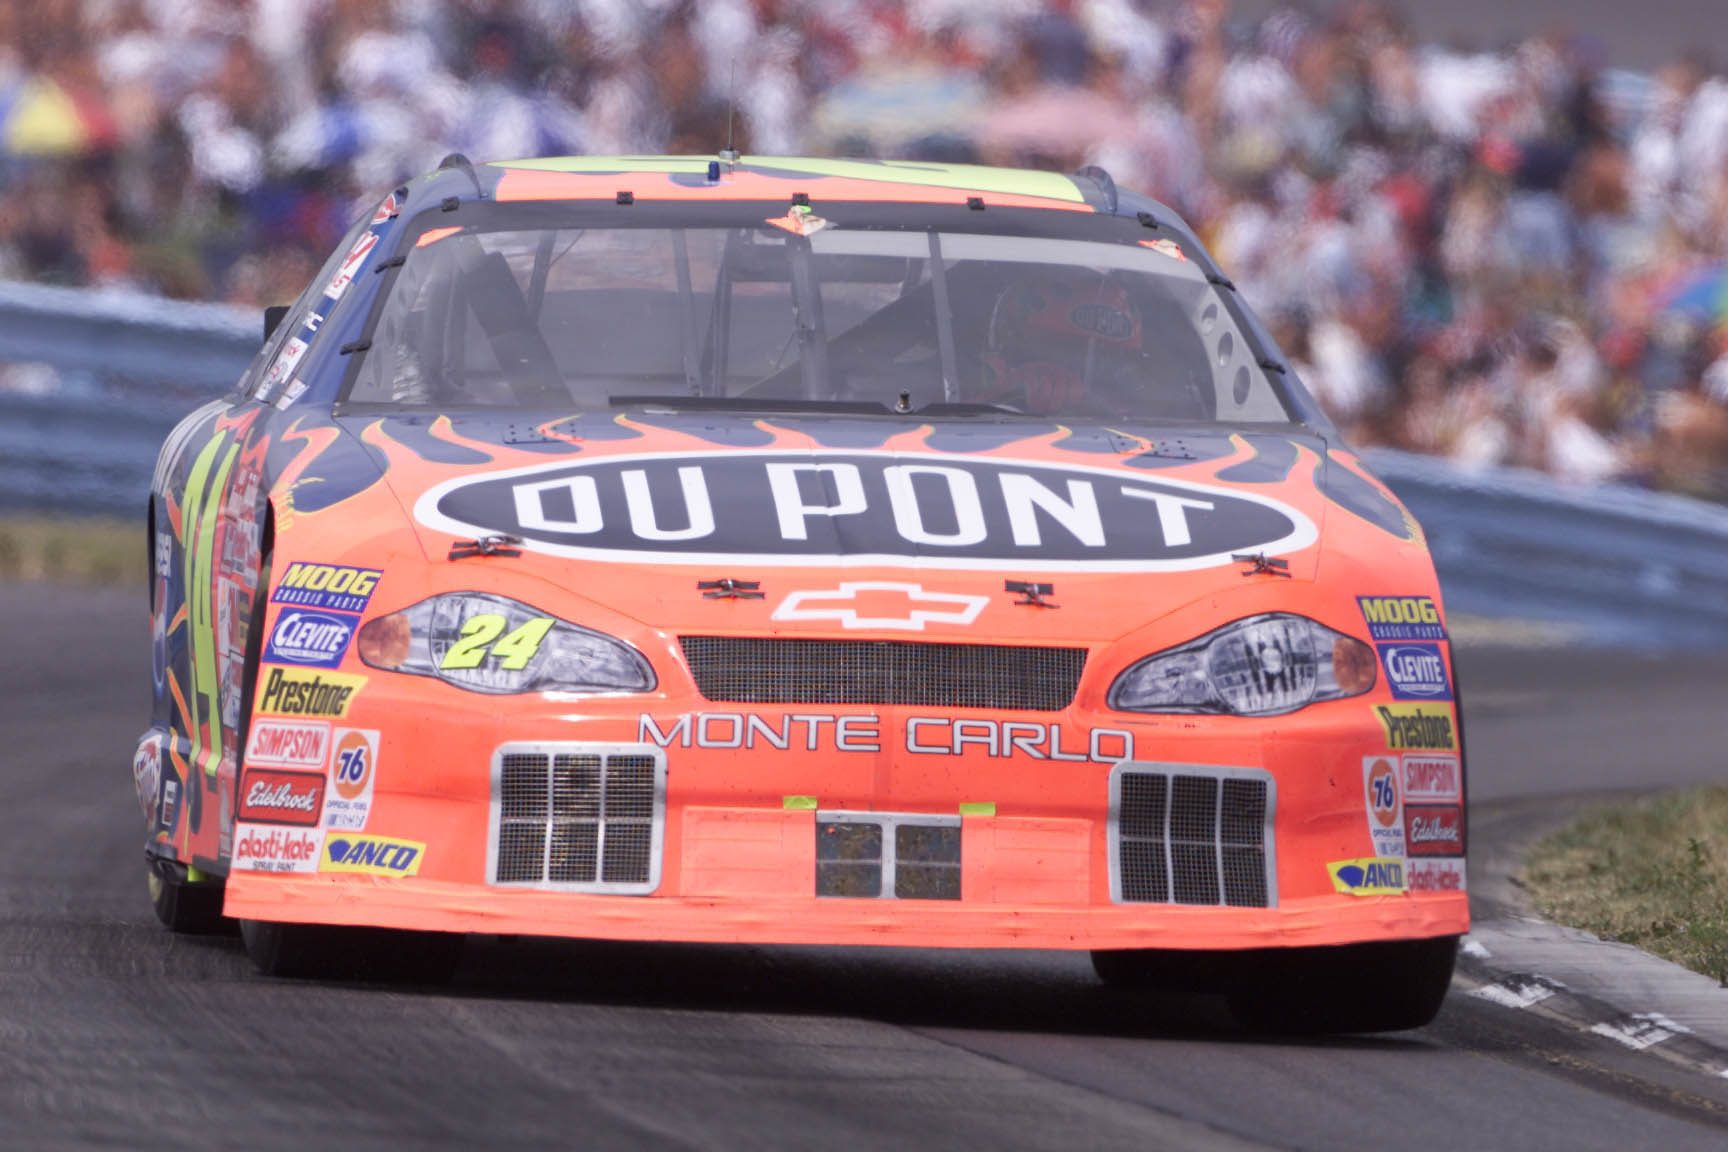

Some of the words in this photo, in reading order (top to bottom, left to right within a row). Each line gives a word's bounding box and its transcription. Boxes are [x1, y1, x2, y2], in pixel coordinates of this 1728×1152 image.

[512, 466, 715, 540] DU
[765, 463, 1214, 547] PONT
[279, 563, 382, 596] MOOG
[1360, 598, 1438, 624] MOOG
[274, 612, 350, 652] CLEVITE
[439, 614, 556, 671] 24
[1386, 648, 1443, 682] CLEVITE
[261, 668, 353, 716] Prestone
[252, 727, 325, 760] SIMPSON
[637, 712, 881, 752] MONTE
[906, 717, 1134, 764] CARLO
[338, 748, 365, 782] 76
[246, 780, 316, 812] Edelbrock
[1374, 775, 1394, 809] 76
[237, 829, 315, 861] plasti-kote
[342, 840, 418, 871] ANCO
